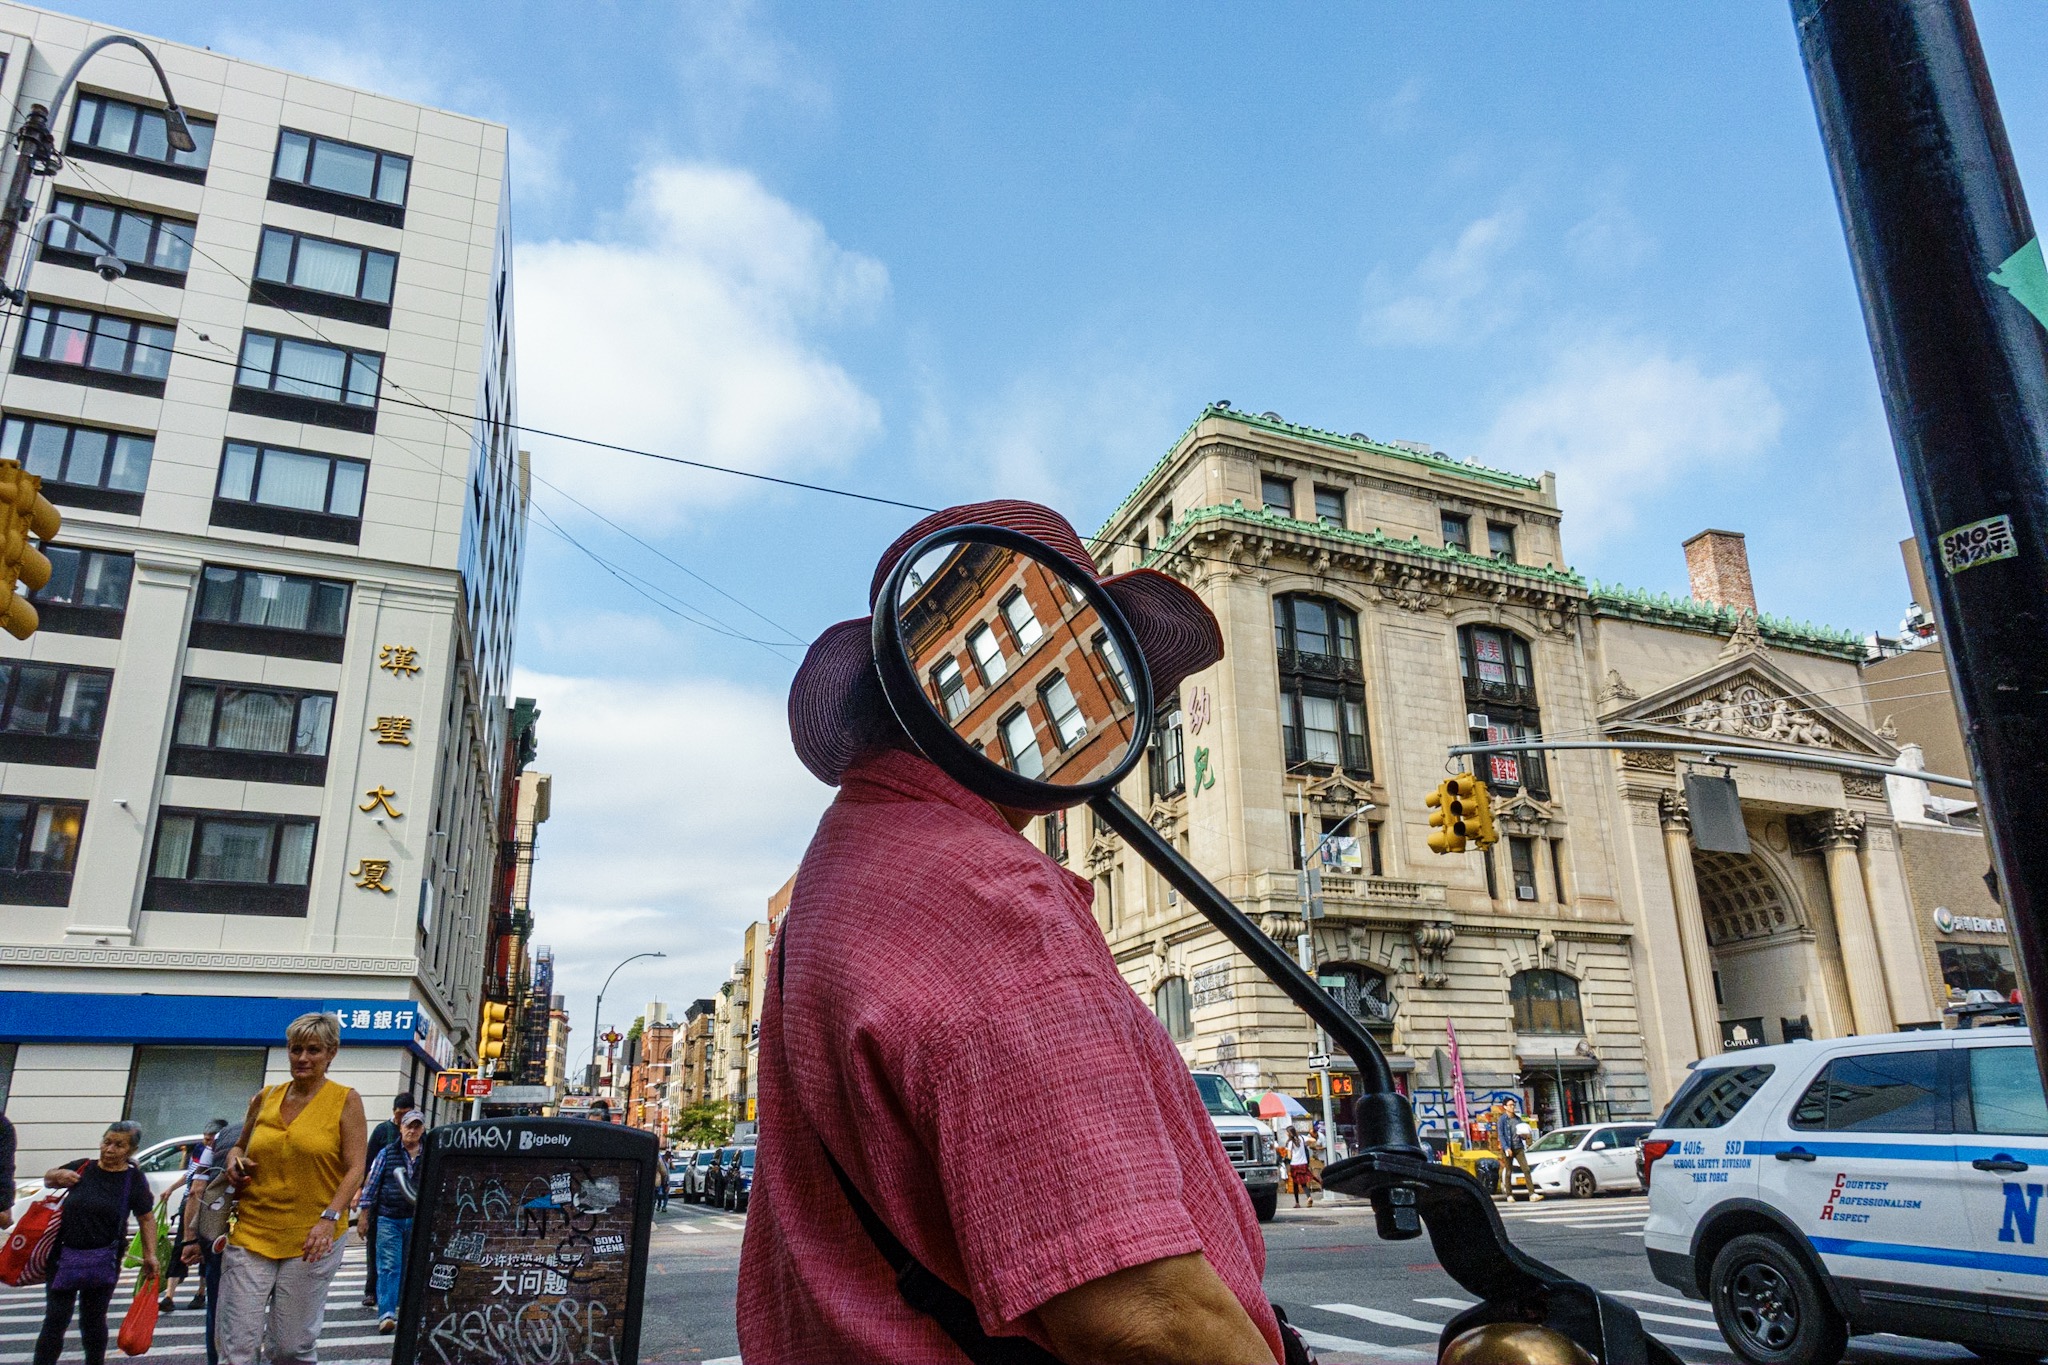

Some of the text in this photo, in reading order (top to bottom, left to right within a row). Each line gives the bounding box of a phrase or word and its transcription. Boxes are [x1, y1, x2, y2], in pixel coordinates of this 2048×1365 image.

[1759, 774, 1803, 793] SAVINGS
[1805, 781, 1834, 796] BANK
[1723, 1038, 1760, 1048] CAPITALE
[519, 1130, 572, 1150] Bigbelly
[1683, 1141, 1702, 1155] 4016
[1725, 1140, 1742, 1155] SSD
[1673, 1158, 1752, 1169] SCHOOL SAFETY DIVISION
[1693, 1172, 1729, 1183] TASK FORCE
[491, 1269, 570, 1296] 大问题
